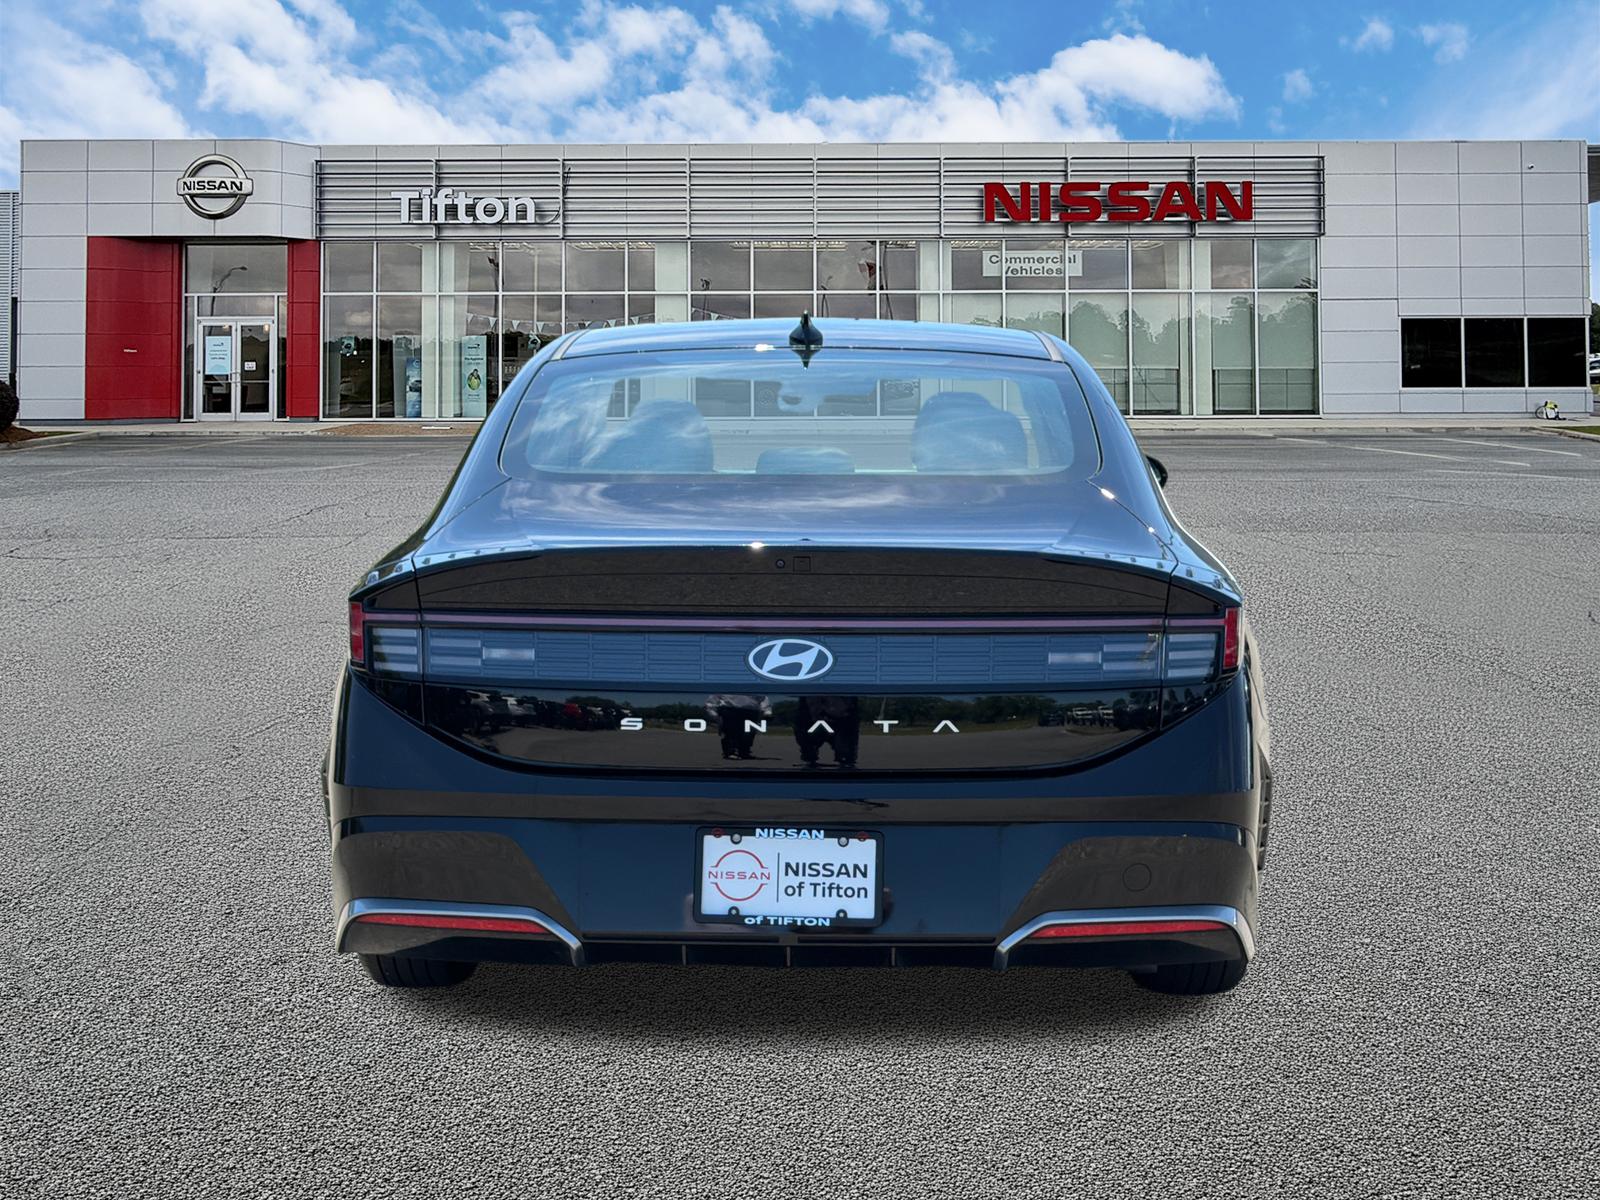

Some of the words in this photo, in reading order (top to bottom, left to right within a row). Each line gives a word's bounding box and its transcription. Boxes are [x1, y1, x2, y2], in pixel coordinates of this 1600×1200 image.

[182, 180, 243, 192] NISSAN
[391, 188, 536, 224] Tifton
[983, 180, 1253, 222] NISSAN
[620, 717, 960, 733] SONATA
[755, 828, 825, 840] NISSAN
[708, 871, 771, 881] NISSAN
[784, 862, 868, 878] NISSAN
[784, 881, 805, 897] of
[810, 882, 868, 899] Tifton
[744, 915, 764, 925] of
[767, 916, 831, 927] TIFTON
